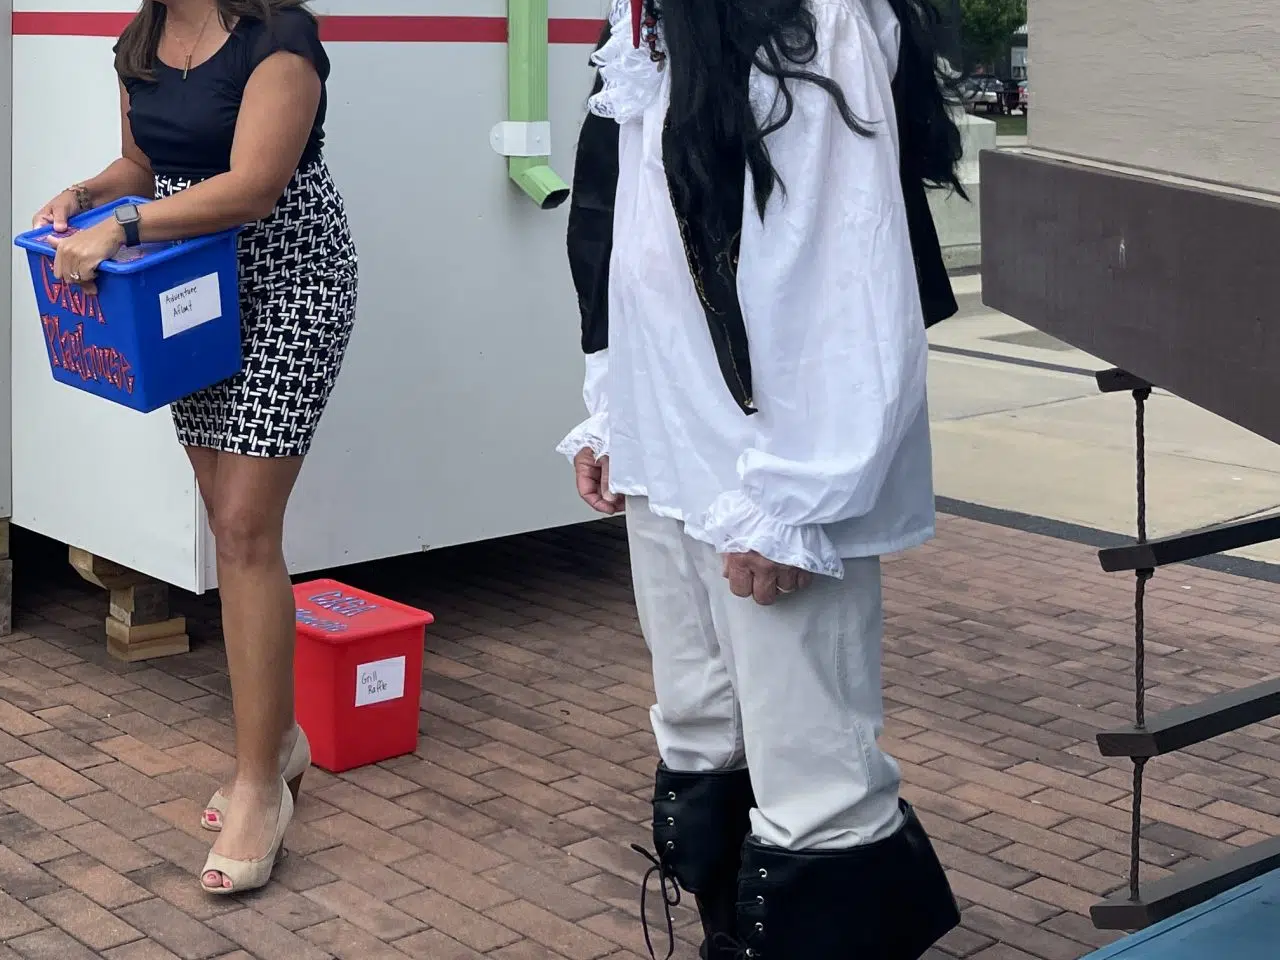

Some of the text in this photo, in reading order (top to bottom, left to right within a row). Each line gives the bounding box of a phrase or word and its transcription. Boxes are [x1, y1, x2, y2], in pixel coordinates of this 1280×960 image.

[166, 286, 197, 304] Adventure
[361, 670, 377, 684] Grill
[368, 679, 388, 694] Raffle
